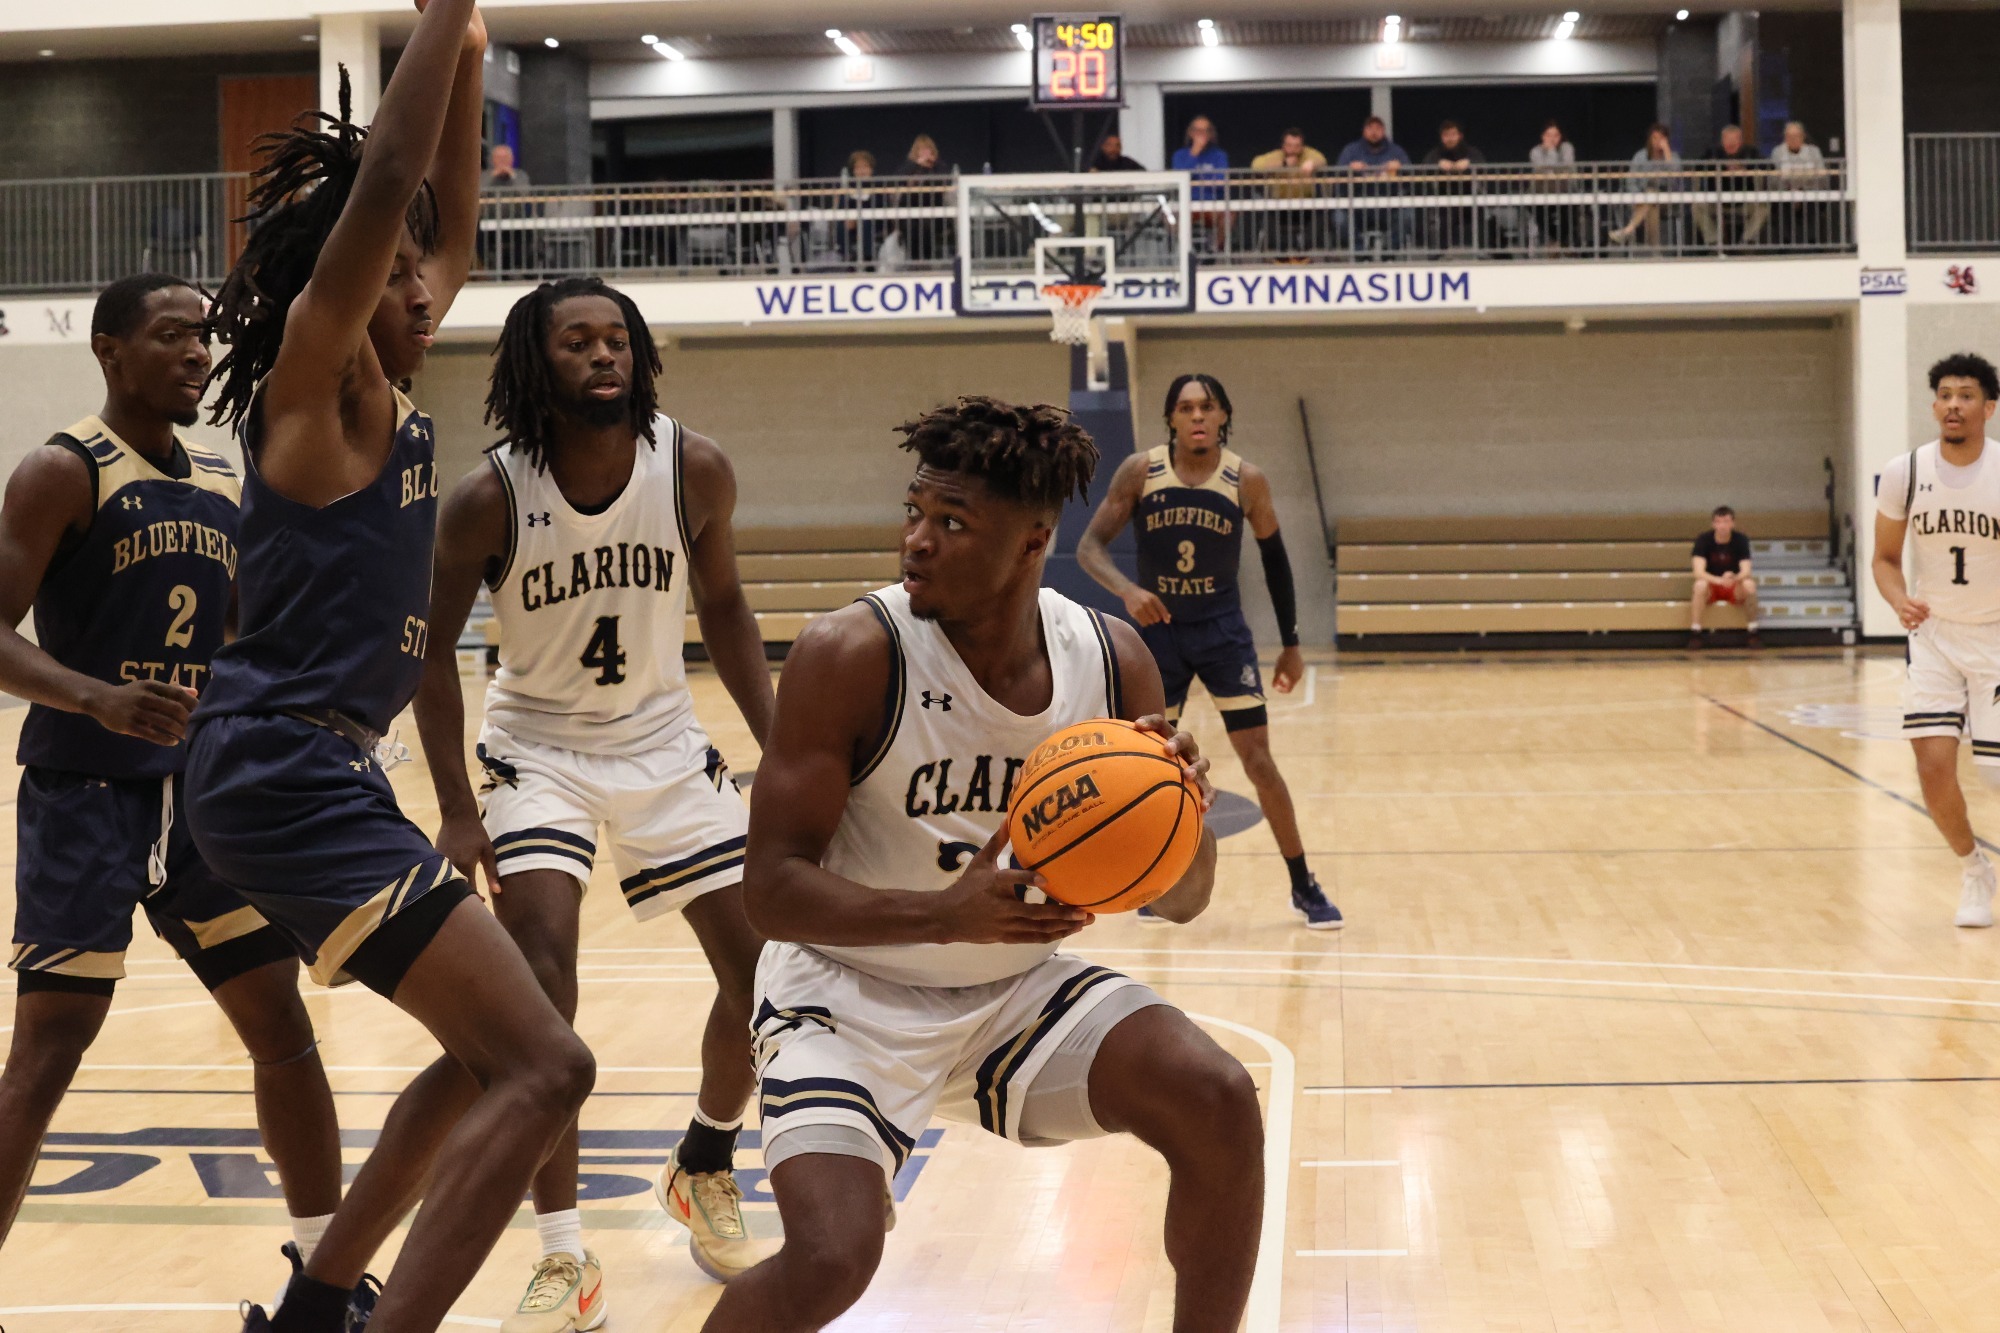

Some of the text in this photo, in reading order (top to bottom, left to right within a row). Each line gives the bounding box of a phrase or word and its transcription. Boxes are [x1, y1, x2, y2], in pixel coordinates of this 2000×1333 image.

[1056, 23, 1114, 50] 4:50
[1050, 51, 1105, 97] 20
[757, 283, 953, 314] WELCOM
[1207, 273, 1469, 305] GYMNASIUM
[1146, 506, 1233, 536] BLUEFIELD
[112, 520, 238, 581] BLUEFIELD
[1176, 540, 1195, 573] 3
[1949, 546, 1969, 586] 1
[521, 542, 675, 612] CLARION
[1157, 575, 1216, 595] STATE
[164, 584, 197, 649] 2
[579, 615, 627, 686] 4
[119, 660, 213, 691] STAT
[905, 755, 1025, 818] CLAR
[1021, 772, 1101, 842] NCAA
